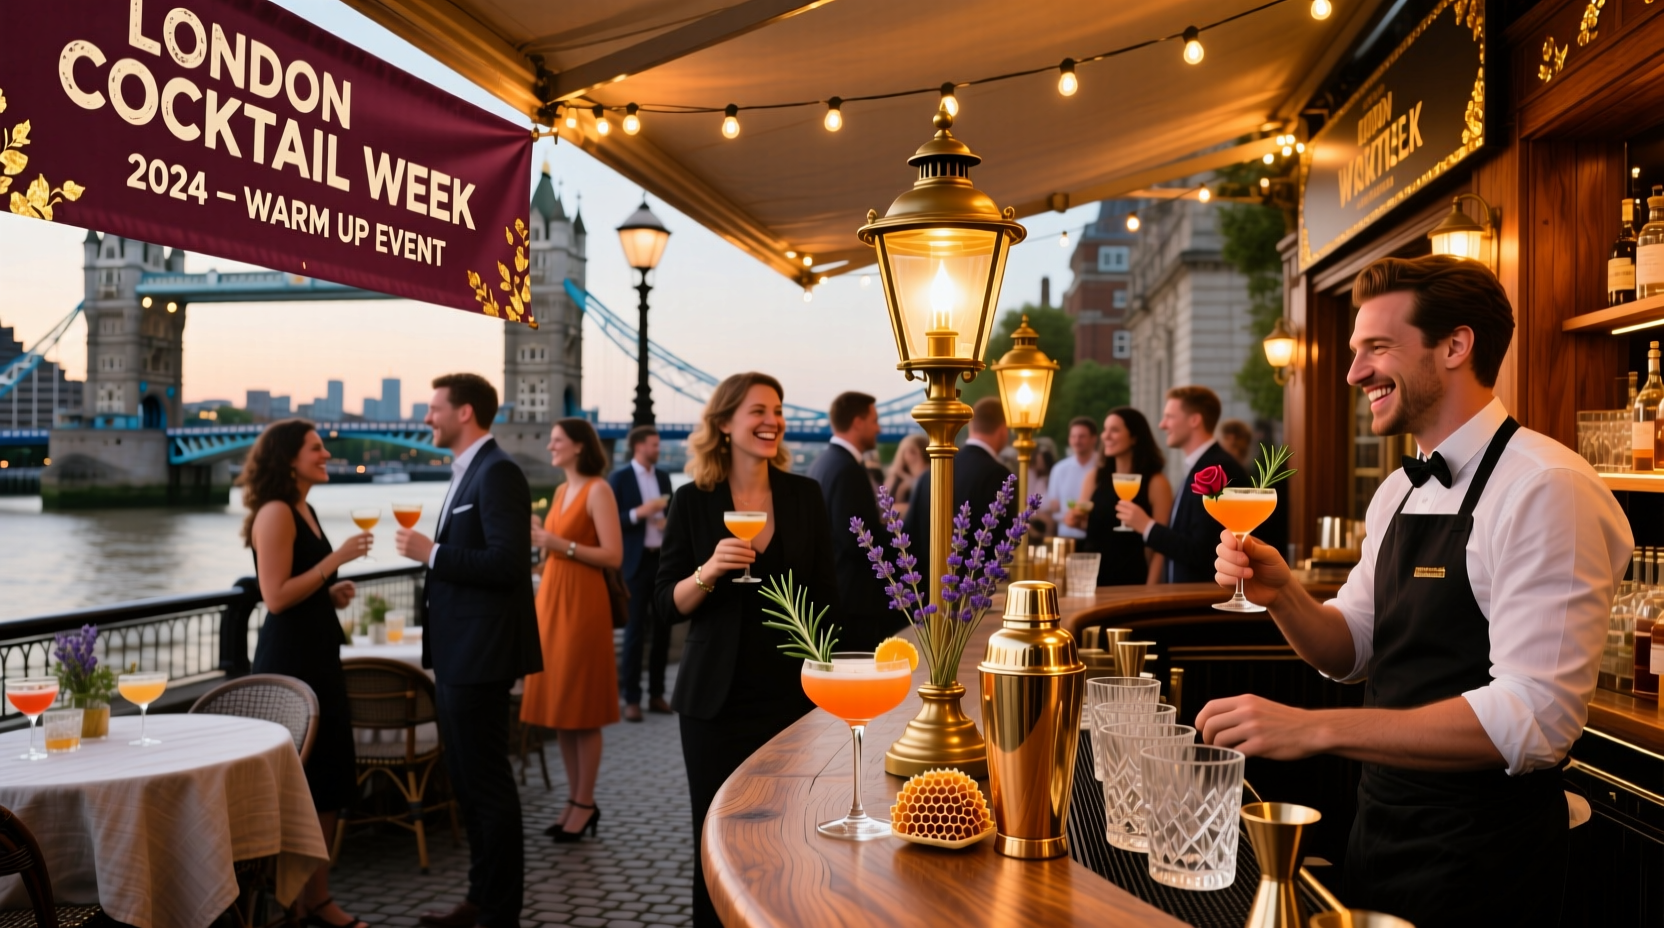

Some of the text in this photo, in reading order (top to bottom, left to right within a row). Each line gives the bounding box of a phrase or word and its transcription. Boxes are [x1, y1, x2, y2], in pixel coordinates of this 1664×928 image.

[129, 0, 352, 130] LONDON
[58, 39, 476, 231] COCKTAIL WEEK
[126, 153, 208, 205] 2024
[243, 186, 330, 238] WARM
[338, 212, 370, 246] UP
[376, 223, 447, 267] EVENT
